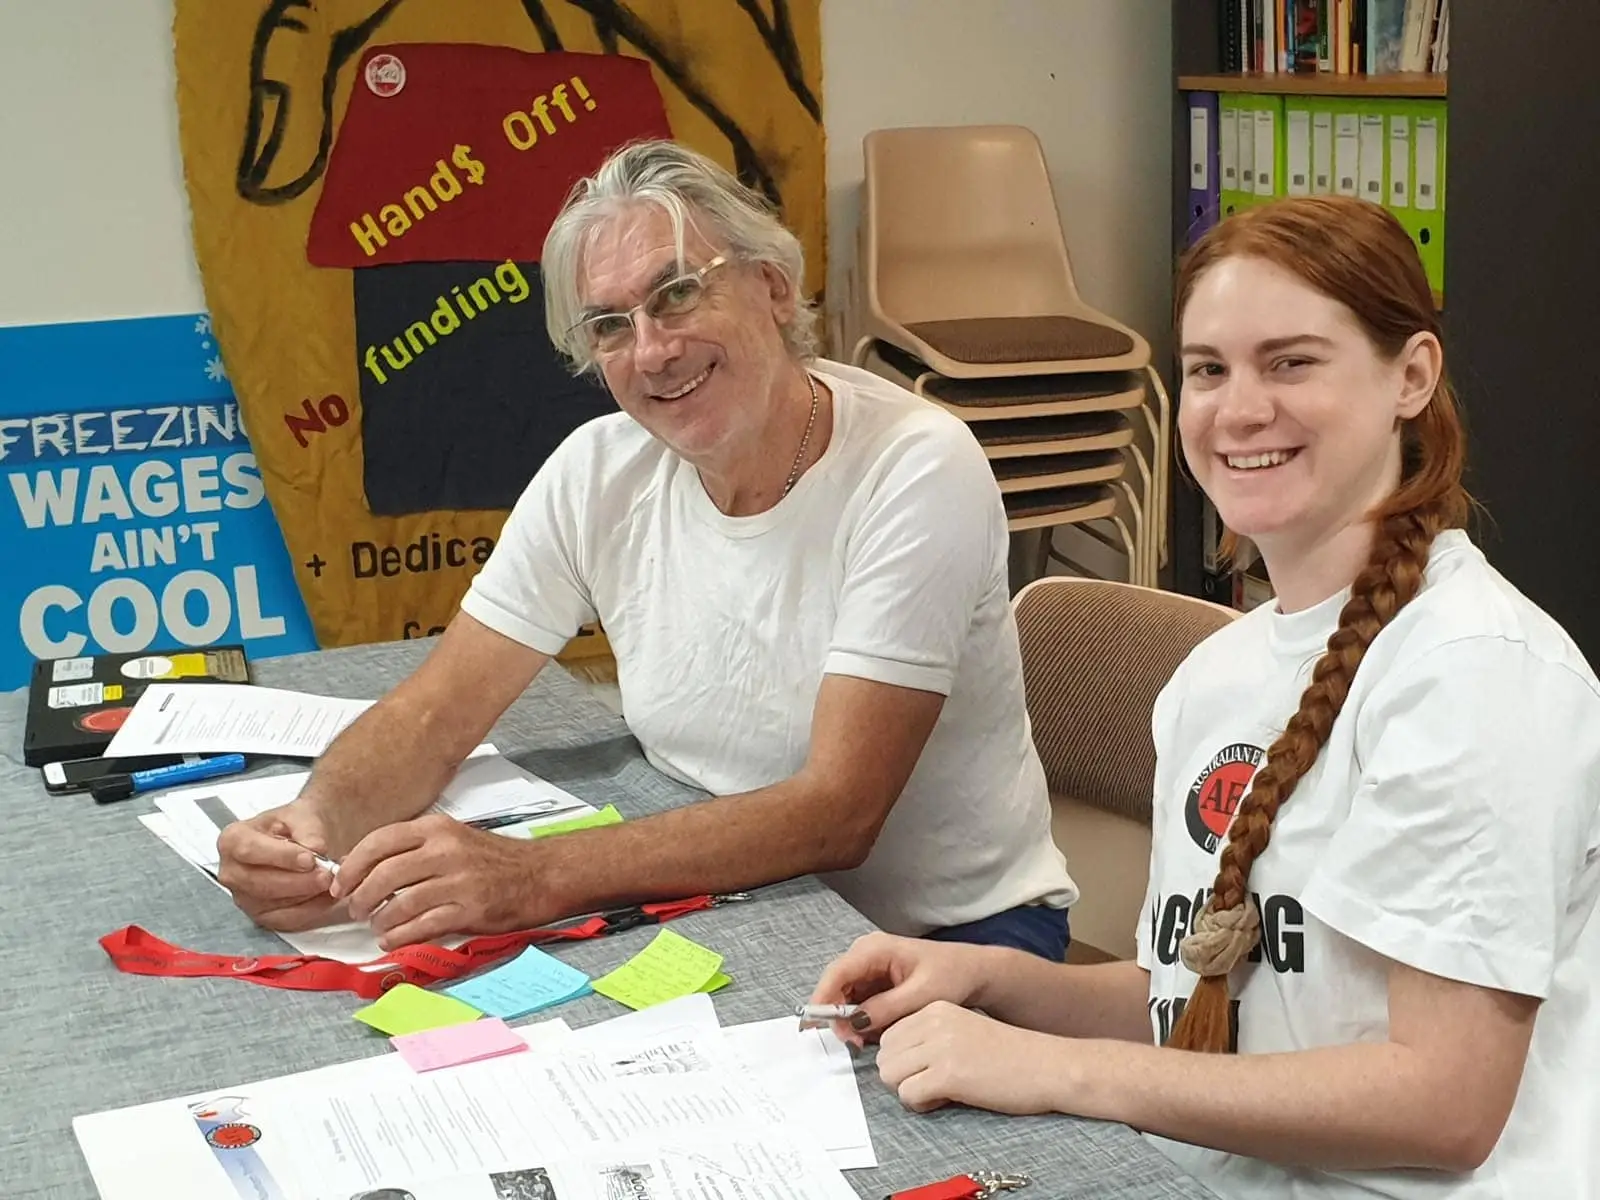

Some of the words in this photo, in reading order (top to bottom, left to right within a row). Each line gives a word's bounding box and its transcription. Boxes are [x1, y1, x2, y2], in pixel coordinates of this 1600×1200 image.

[349, 144, 486, 257] Hand$
[502, 76, 597, 151] Off!
[364, 258, 531, 384] funding
[8, 452, 266, 529] WAGES
[90, 522, 219, 573] AIN'T
[19, 564, 287, 660] COOL
